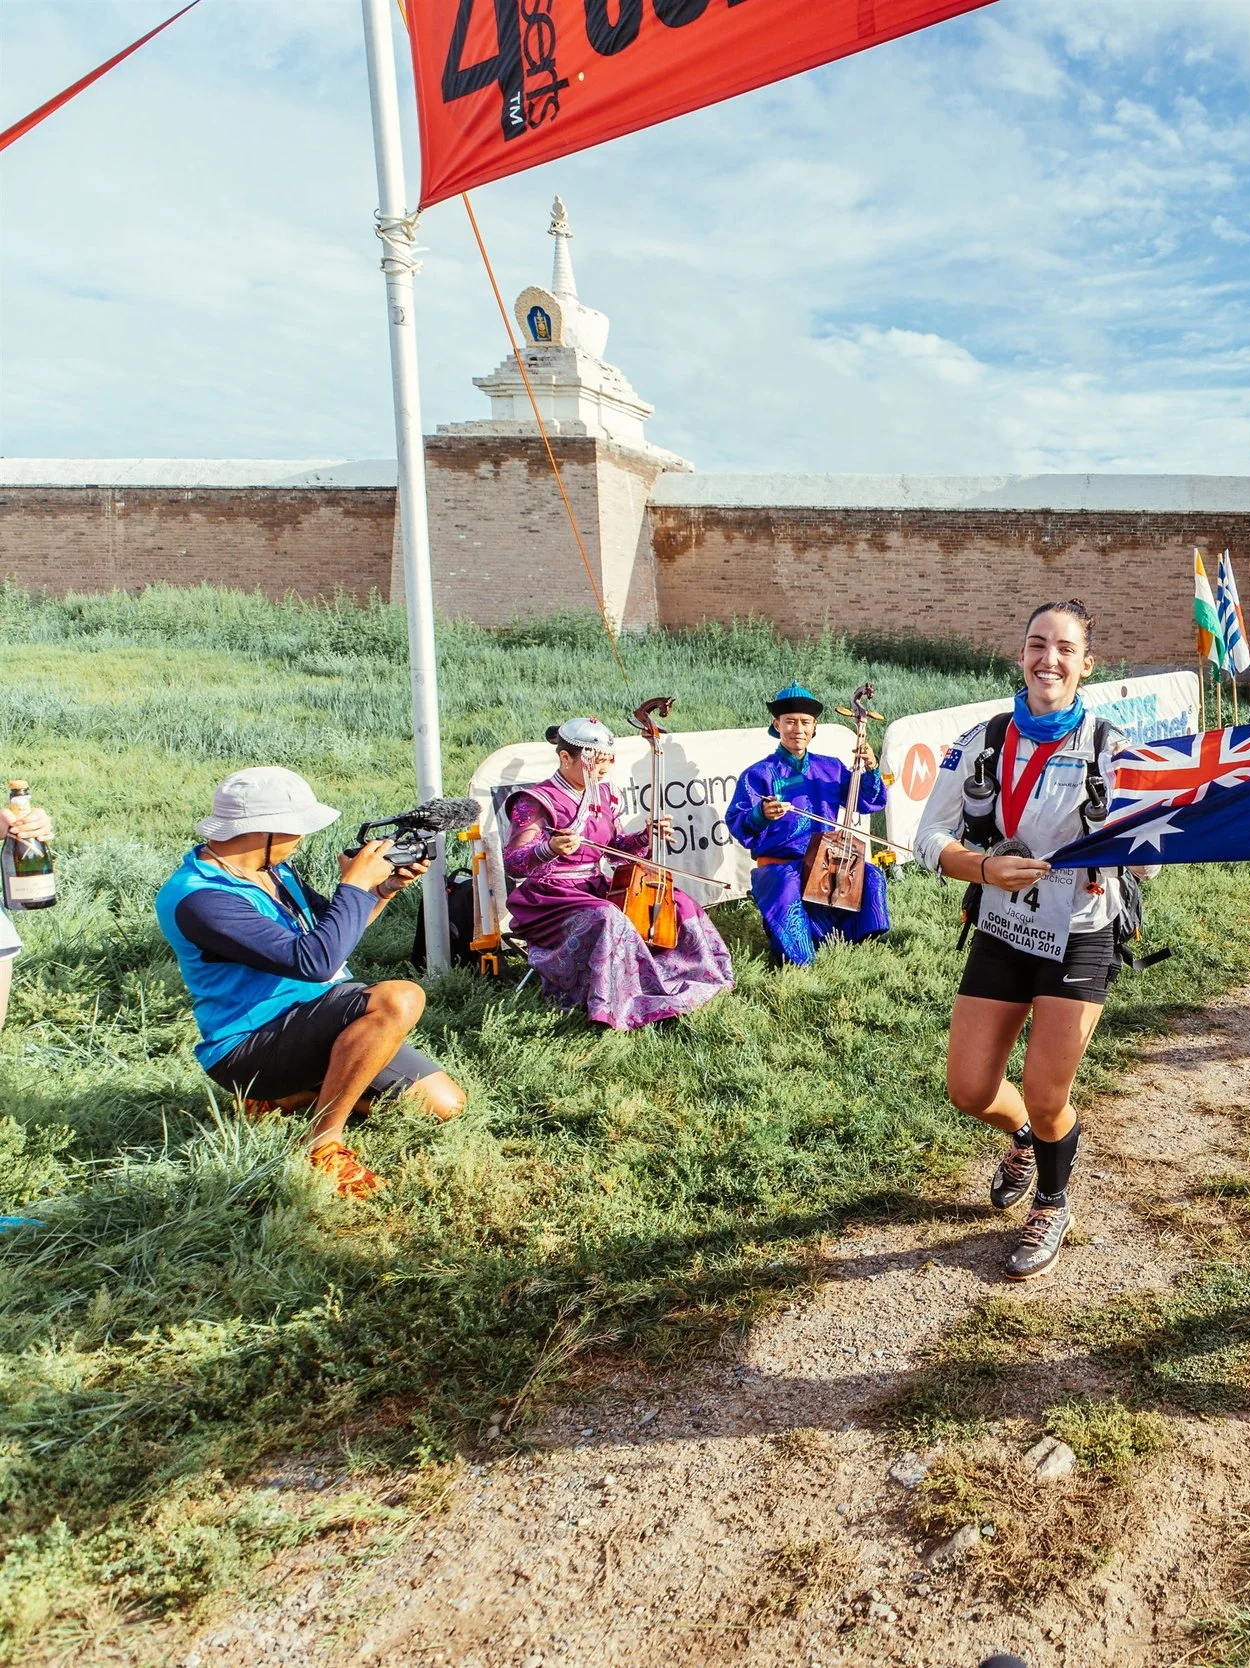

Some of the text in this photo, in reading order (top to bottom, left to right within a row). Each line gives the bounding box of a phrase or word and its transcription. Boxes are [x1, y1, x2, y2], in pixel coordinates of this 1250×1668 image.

[441, 0, 527, 141] 4
[988, 912, 1055, 942] GOBI MARCH
[1006, 907, 1034, 924] Jacqui
[981, 920, 1061, 956] (MONGOLIA) 2018
